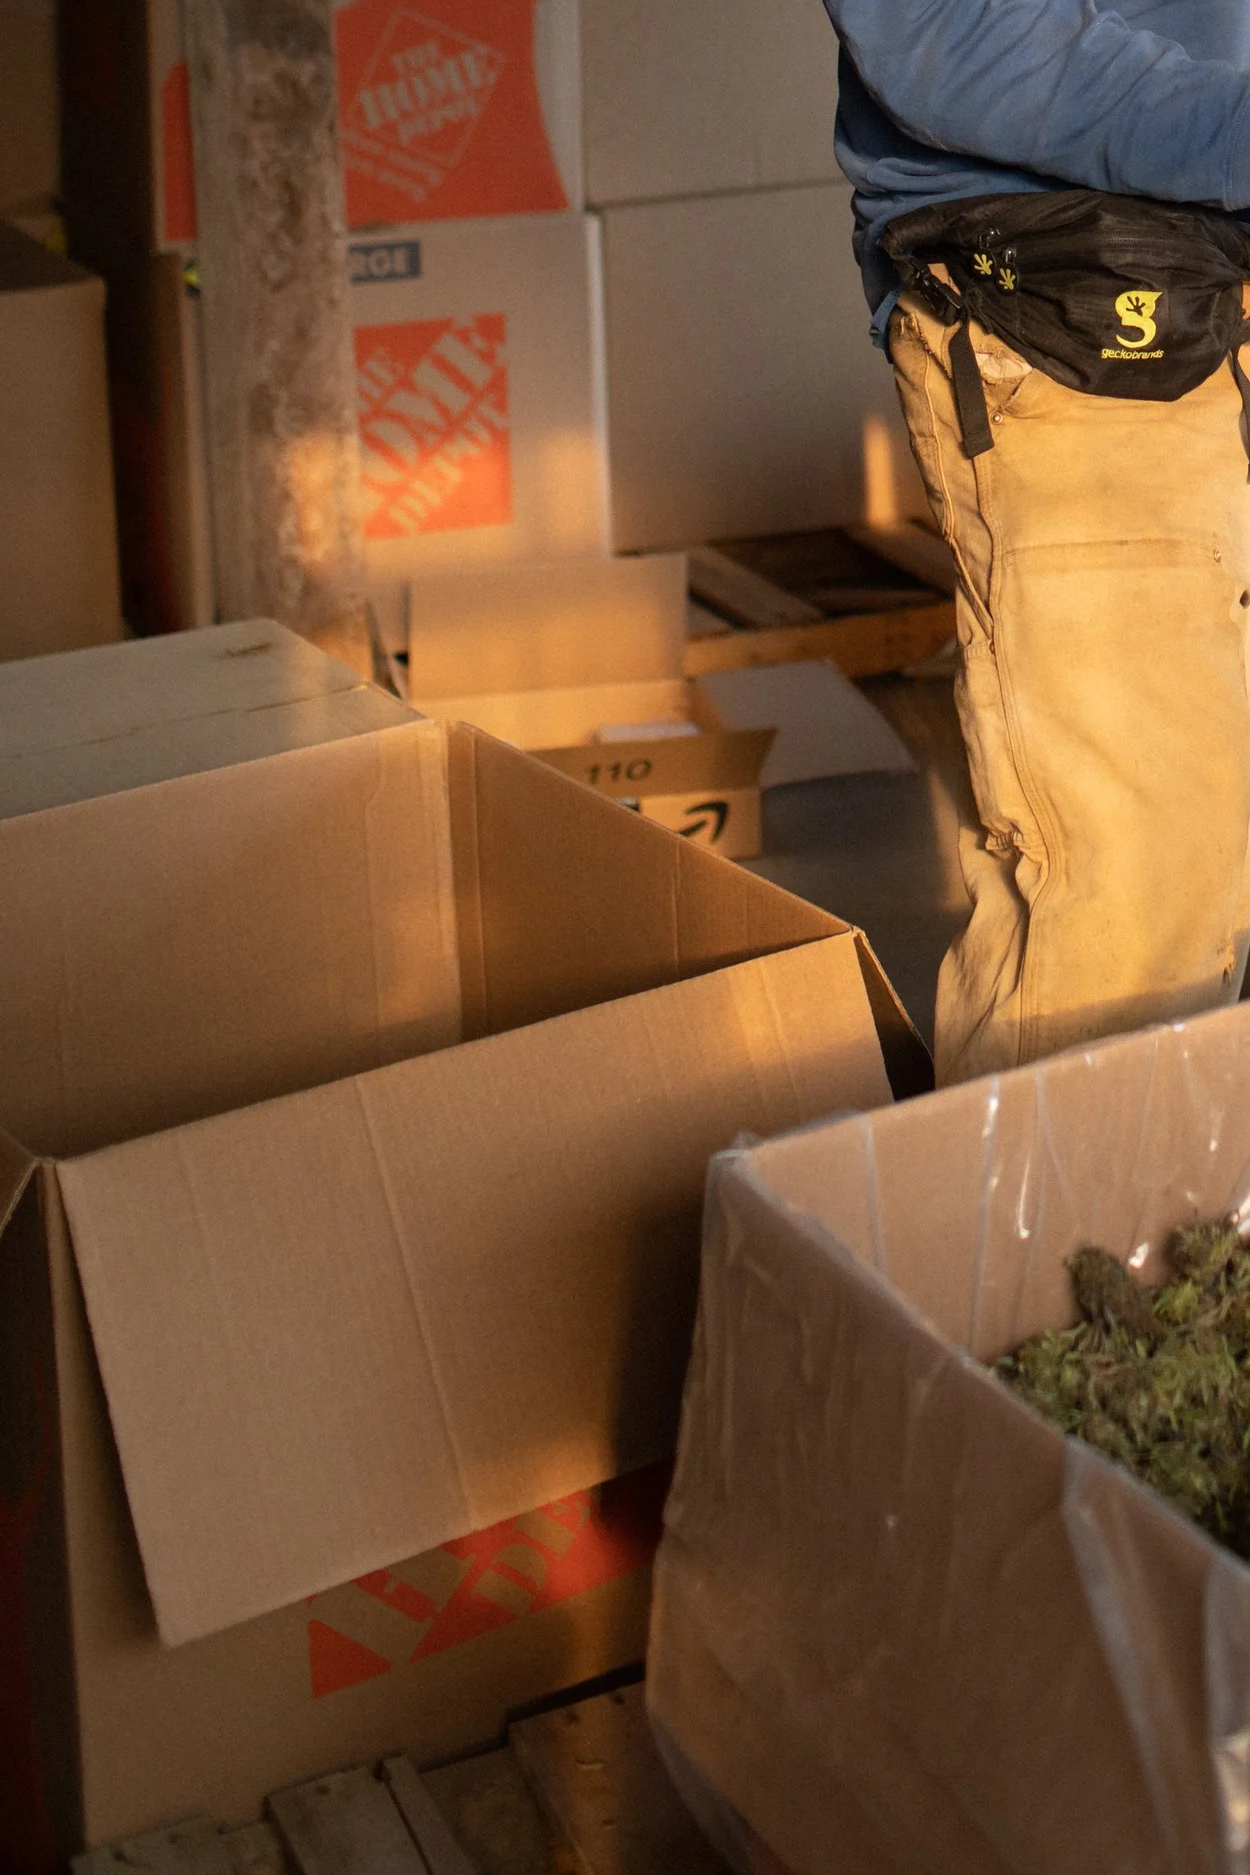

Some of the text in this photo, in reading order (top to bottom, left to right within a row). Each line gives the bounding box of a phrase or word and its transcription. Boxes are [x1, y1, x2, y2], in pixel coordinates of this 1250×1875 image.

[358, 44, 497, 130] HOME
[1101, 348, 1164, 360] geckobrands
[387, 393, 506, 535] DEPOT
[586, 758, 652, 784] 110
